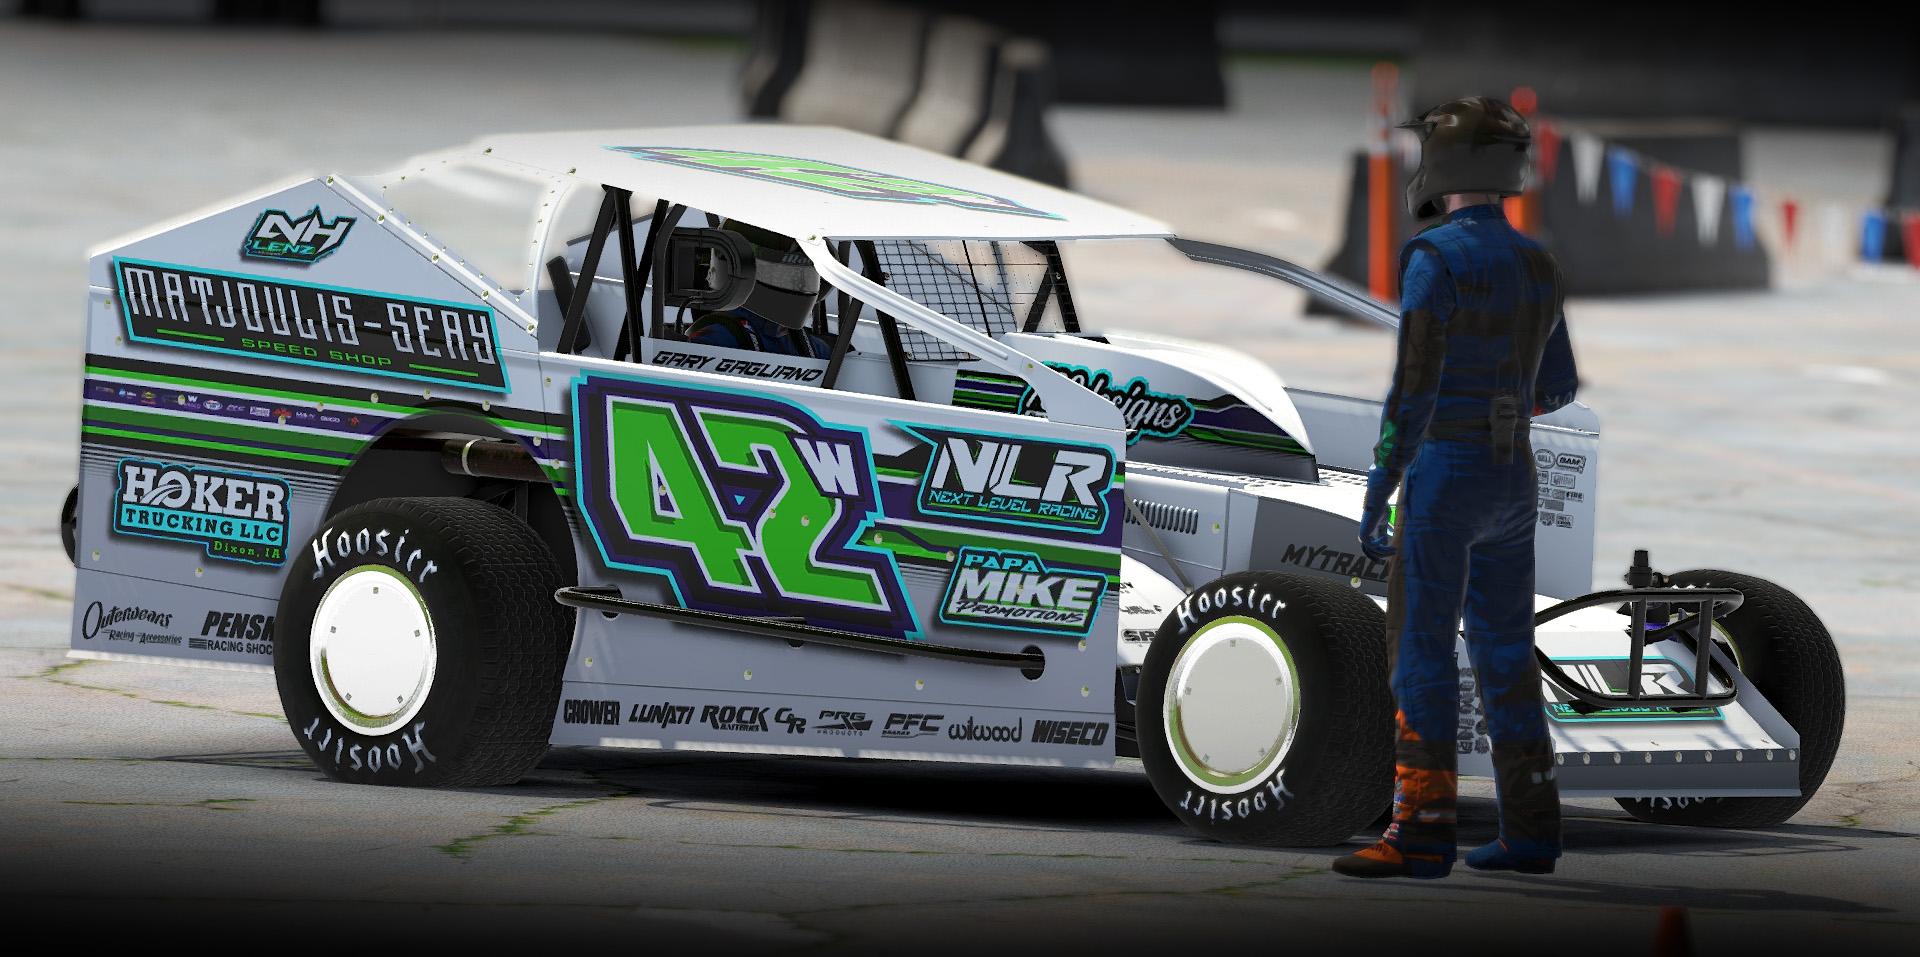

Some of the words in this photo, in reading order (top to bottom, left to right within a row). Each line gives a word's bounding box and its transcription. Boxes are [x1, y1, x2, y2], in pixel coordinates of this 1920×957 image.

[253, 240, 315, 255] LENZ
[255, 214, 350, 253] NH
[124, 266, 496, 364] MATJOULIS-SEAY
[242, 337, 318, 359] SPEED
[330, 349, 392, 367] SHOP
[652, 350, 716, 369] GARY
[715, 358, 823, 382] GAGLIANO
[931, 437, 1107, 507] NLR
[123, 465, 285, 522] HOKER
[928, 490, 974, 505] NEXT
[978, 497, 1032, 513] LEVEL
[1038, 502, 1099, 520] RACING
[126, 508, 234, 536] TRUCKING
[240, 523, 280, 542] LLC
[265, 548, 281, 559] IA
[312, 527, 438, 583] Hoosier
[964, 554, 1039, 573] PAPA
[950, 568, 1100, 610] MIKE
[1176, 583, 1288, 634] Hoosier
[109, 629, 135, 642] Racing
[207, 640, 244, 653] RACING
[563, 699, 621, 726] CROWER
[628, 702, 695, 728] LUNATI
[700, 704, 771, 732] ROCK
[884, 713, 945, 732] PFC
[948, 716, 1023, 742] wilwood
[1031, 720, 1110, 746] WISECO
[303, 718, 437, 775] Hoosier
[1178, 768, 1295, 822] Hoosier
